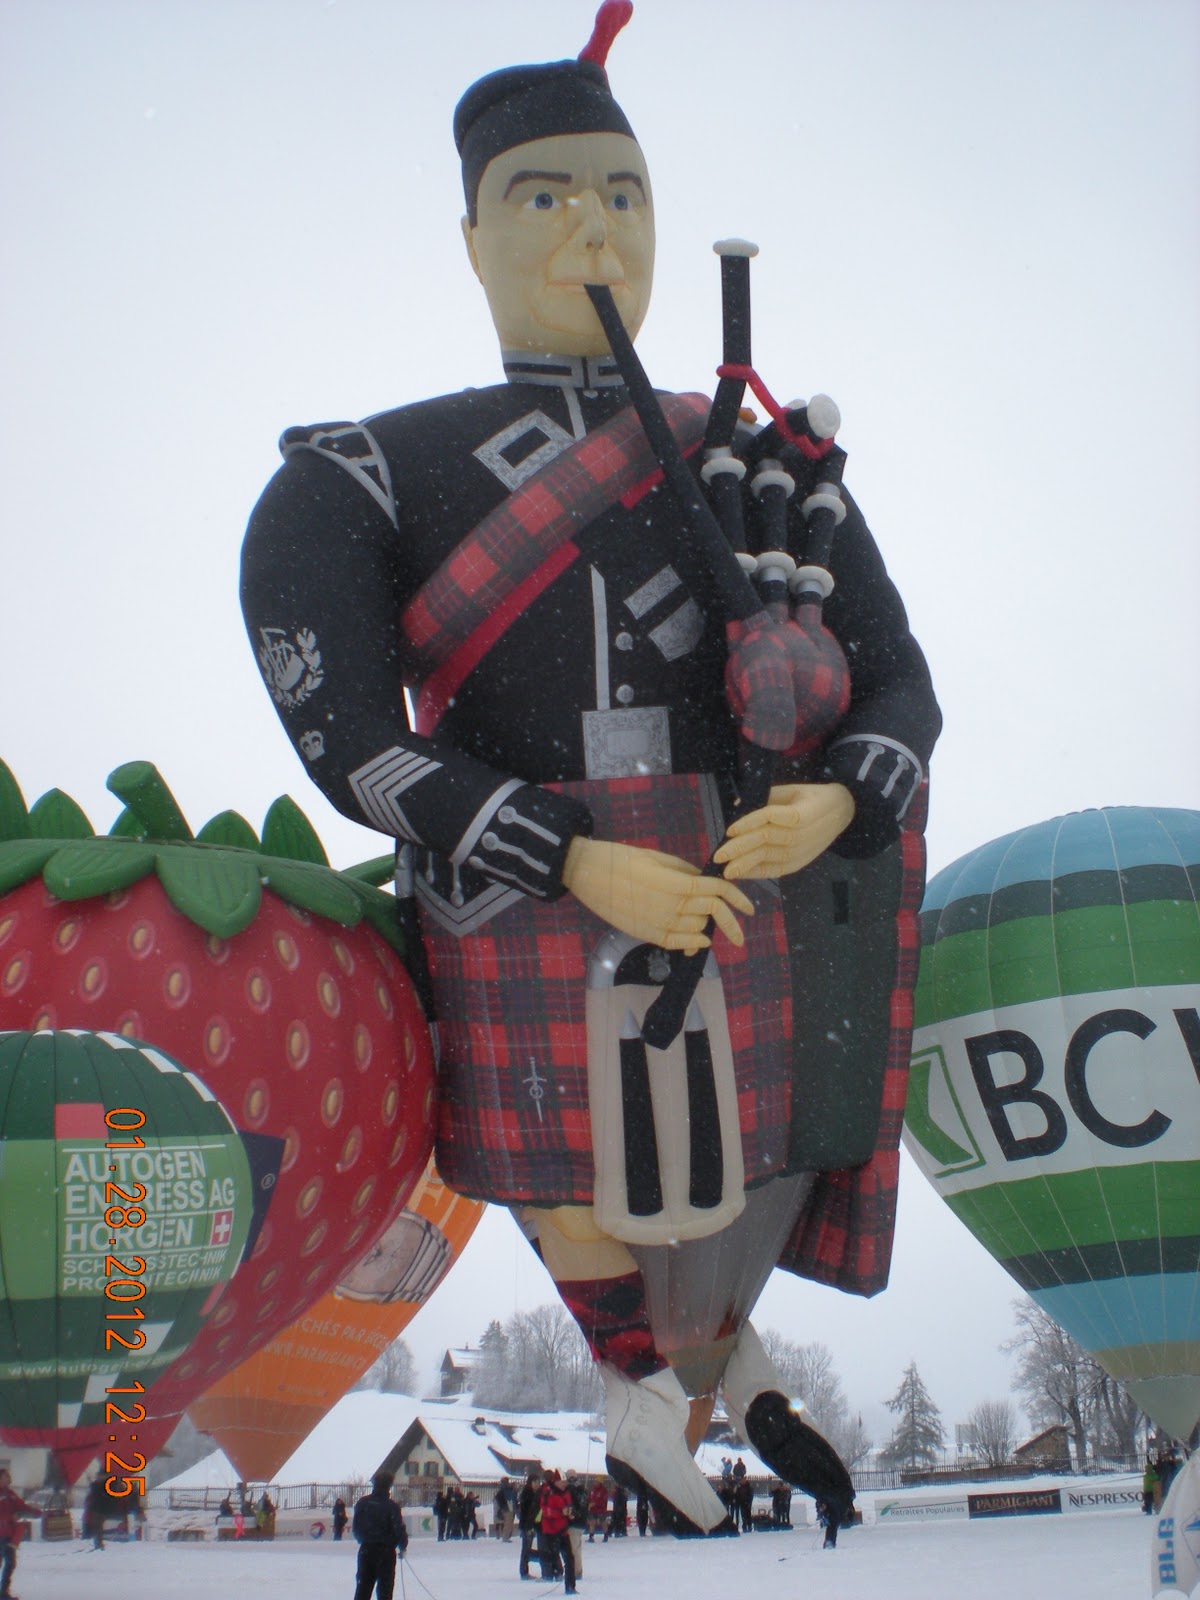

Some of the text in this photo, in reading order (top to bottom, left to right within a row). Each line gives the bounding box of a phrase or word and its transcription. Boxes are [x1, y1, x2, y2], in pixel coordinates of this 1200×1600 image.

[64, 1151, 206, 1182] AUTOGEN
[64, 1177, 235, 1214] ENDRESS AG
[64, 1217, 194, 1252] HORGEN
[63, 1267, 222, 1291] PRONTECHNIK
[890, 1506, 965, 1516] Retraites Populaires
[976, 1494, 1055, 1509] PARMIGIANI
[1068, 1492, 1144, 1508] NESPRESSO
